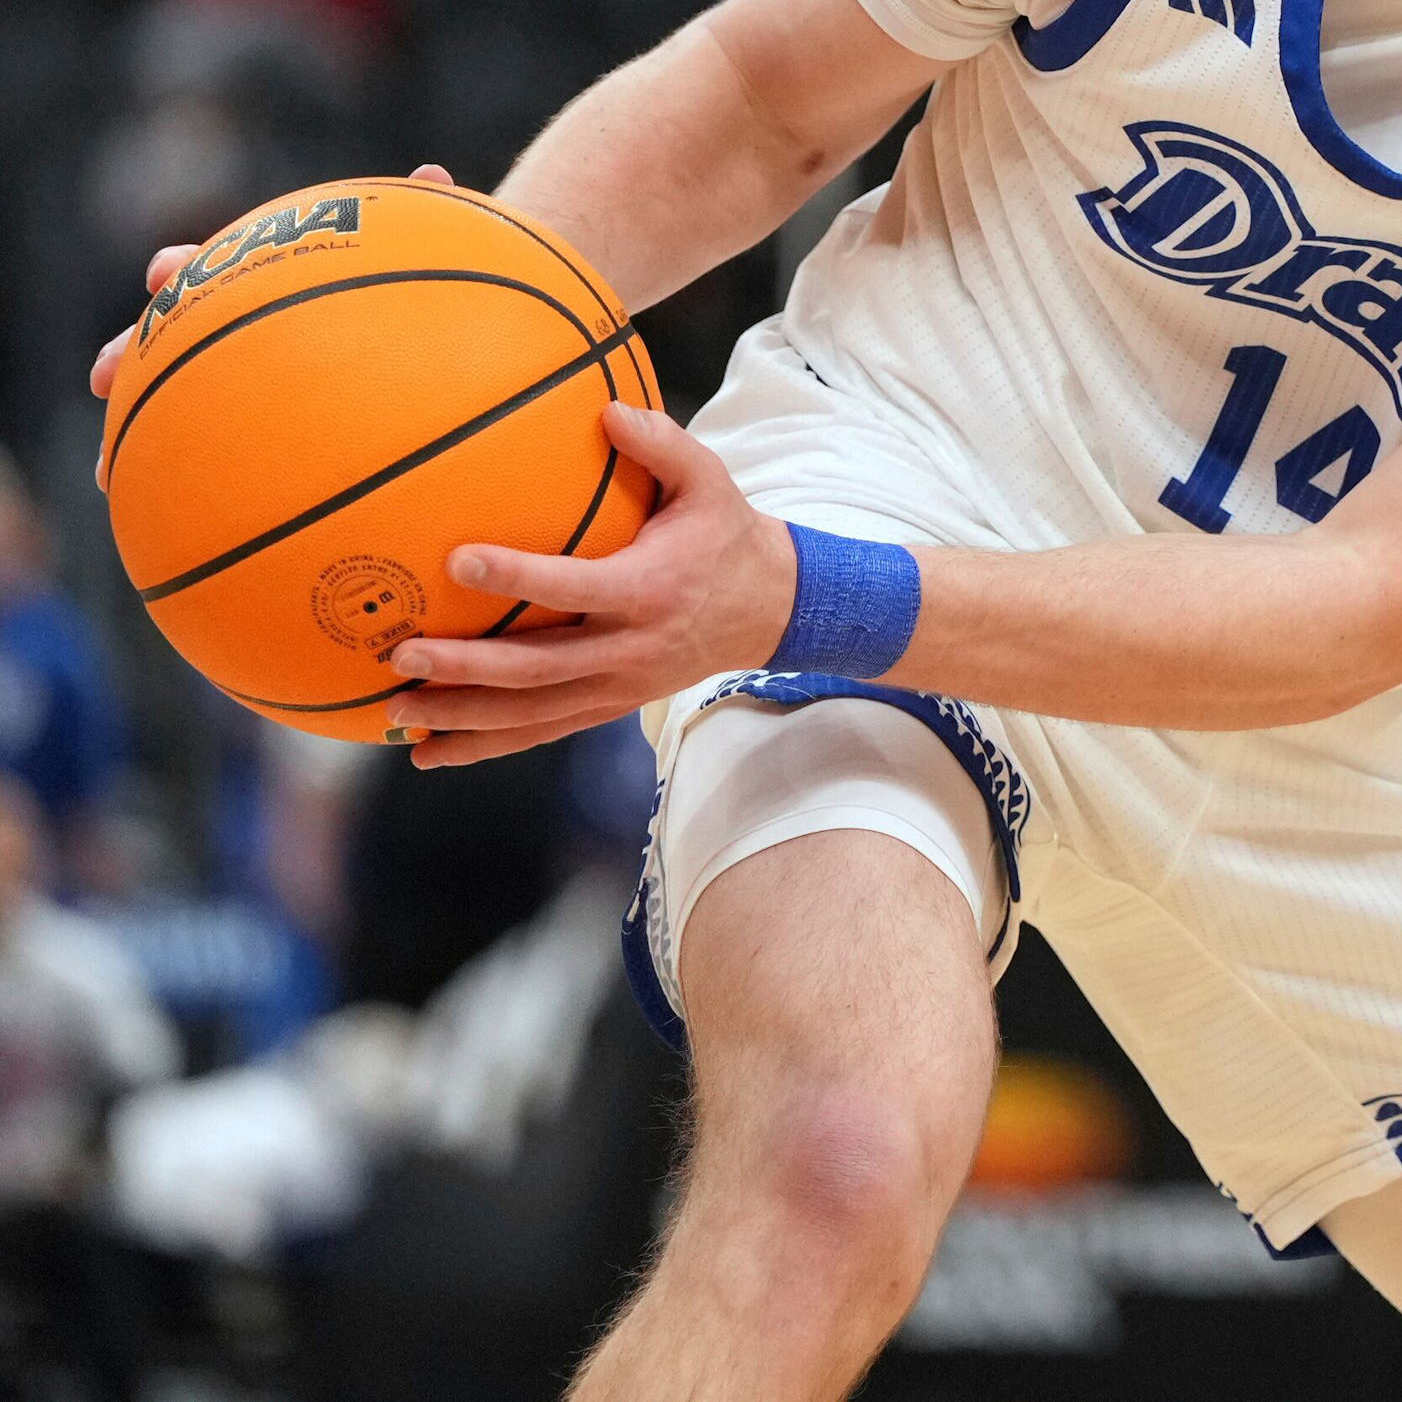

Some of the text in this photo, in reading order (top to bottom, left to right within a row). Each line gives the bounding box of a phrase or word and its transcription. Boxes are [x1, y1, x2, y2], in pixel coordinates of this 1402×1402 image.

[137, 196, 360, 348] NCAA
[138, 239, 361, 361] OFFICIAL GAME BALL
[381, 621, 411, 640] SIZE
